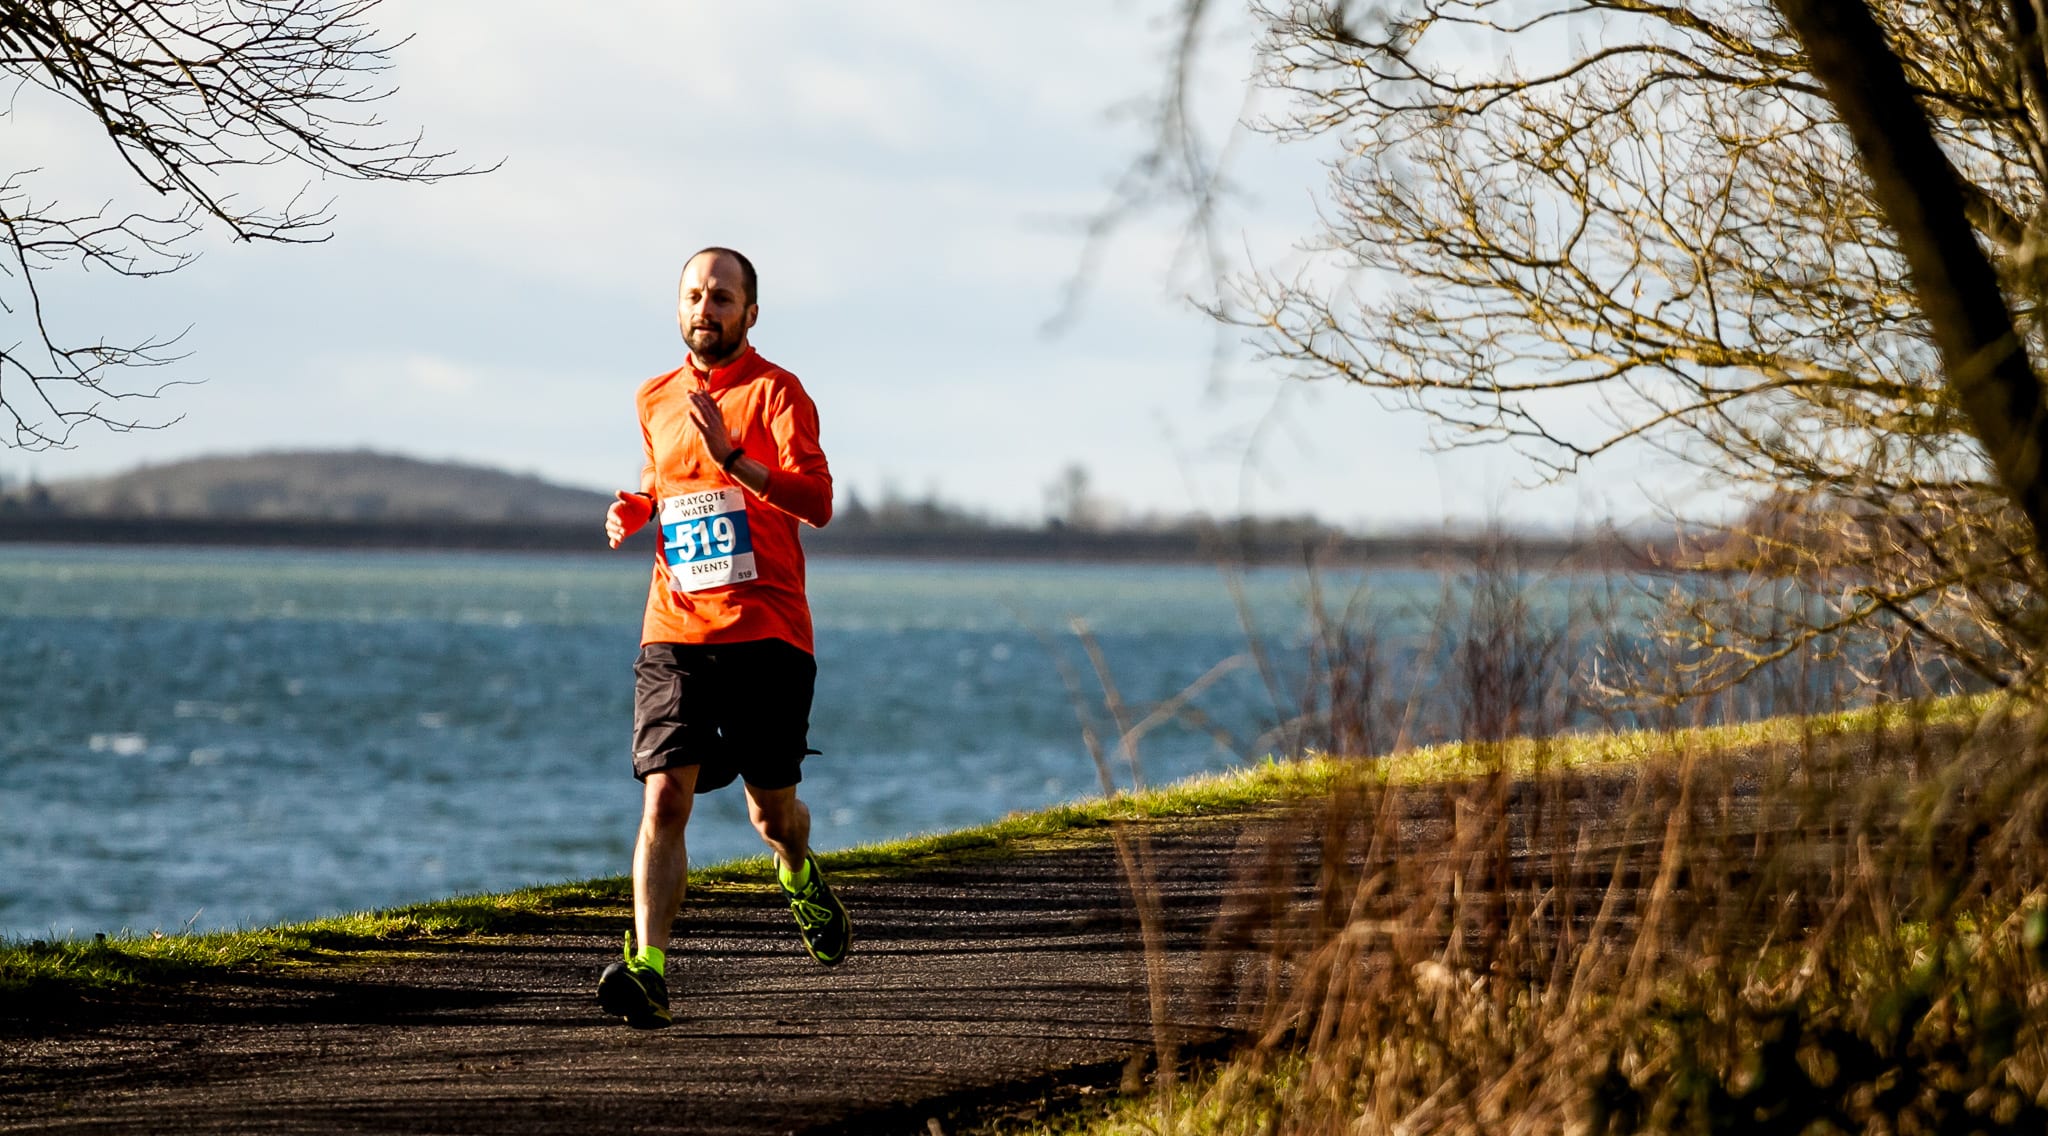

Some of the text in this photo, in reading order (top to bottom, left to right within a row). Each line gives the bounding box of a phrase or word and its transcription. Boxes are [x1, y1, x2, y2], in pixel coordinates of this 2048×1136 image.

[674, 490, 726, 508] DRAYCOTE
[682, 504, 716, 517] WATER
[675, 517, 736, 561] 519
[691, 560, 729, 574] EVENTS
[738, 570, 752, 579] 519
